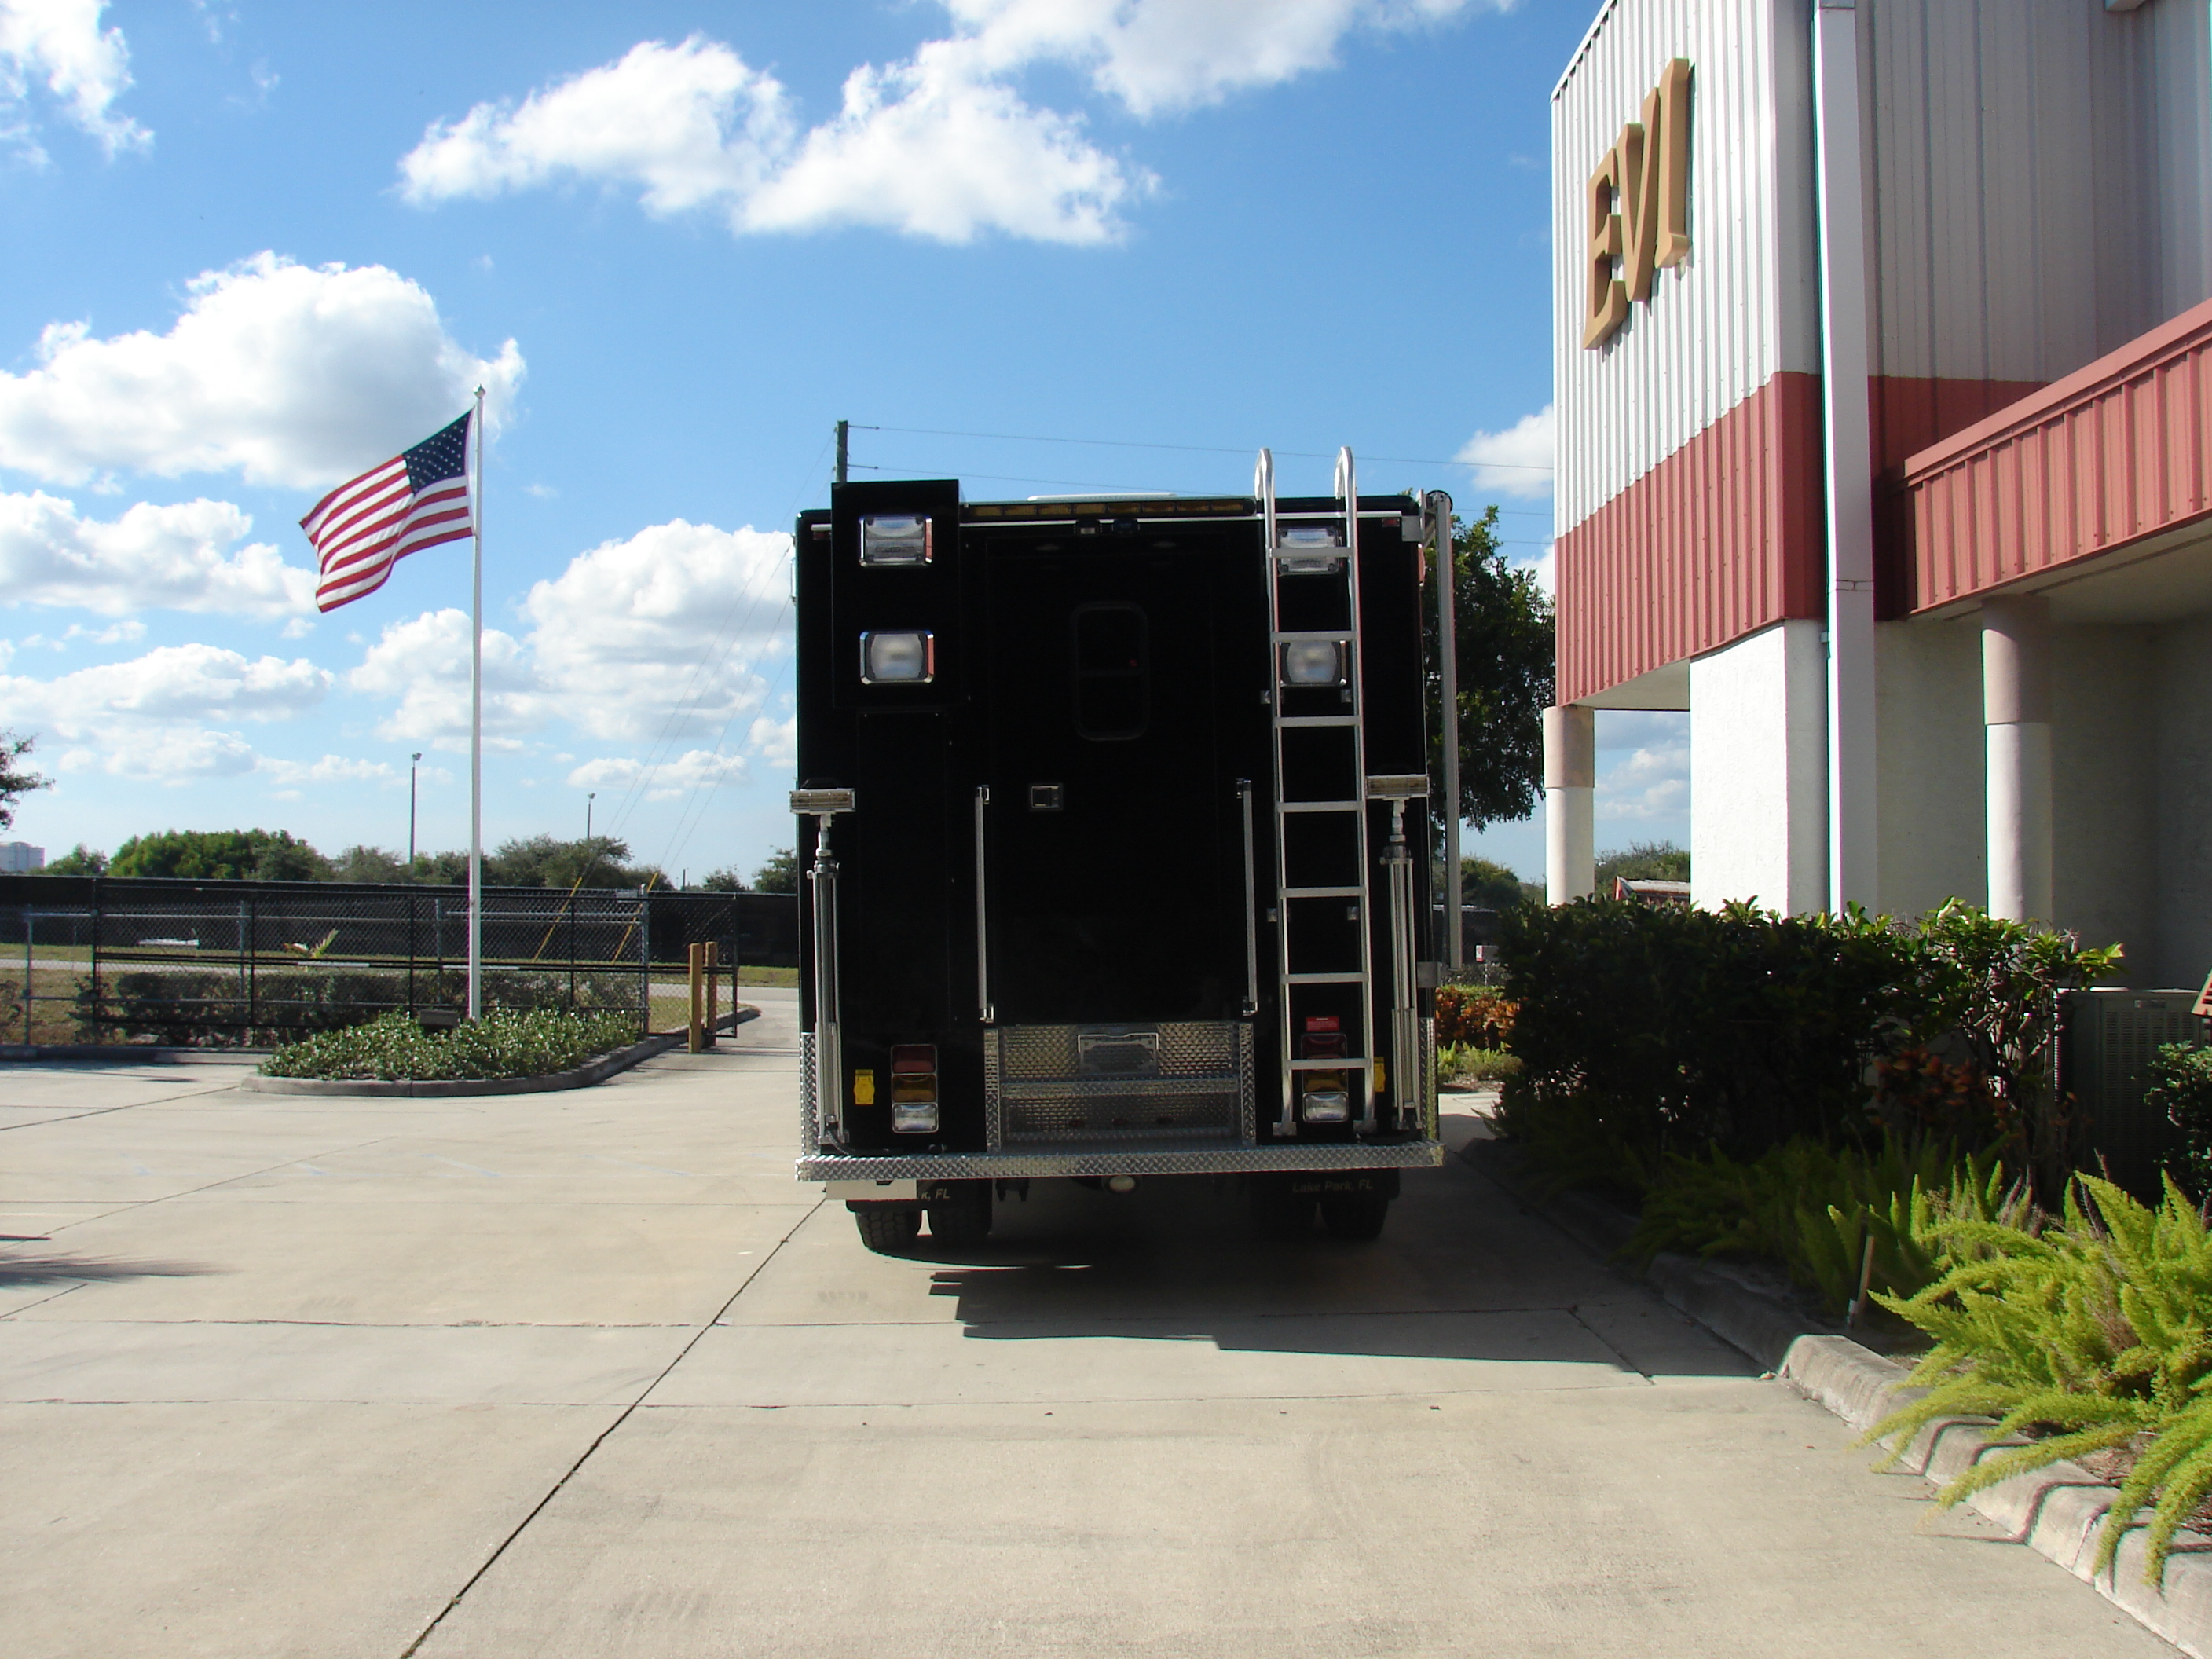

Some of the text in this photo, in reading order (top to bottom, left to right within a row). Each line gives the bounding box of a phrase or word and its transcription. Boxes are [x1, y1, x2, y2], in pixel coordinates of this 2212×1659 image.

[1583, 57, 1690, 350] EVI
[1291, 1181, 1321, 1193] Lake
[1358, 1179, 1374, 1190] FL
[935, 1188, 950, 1199] FL
